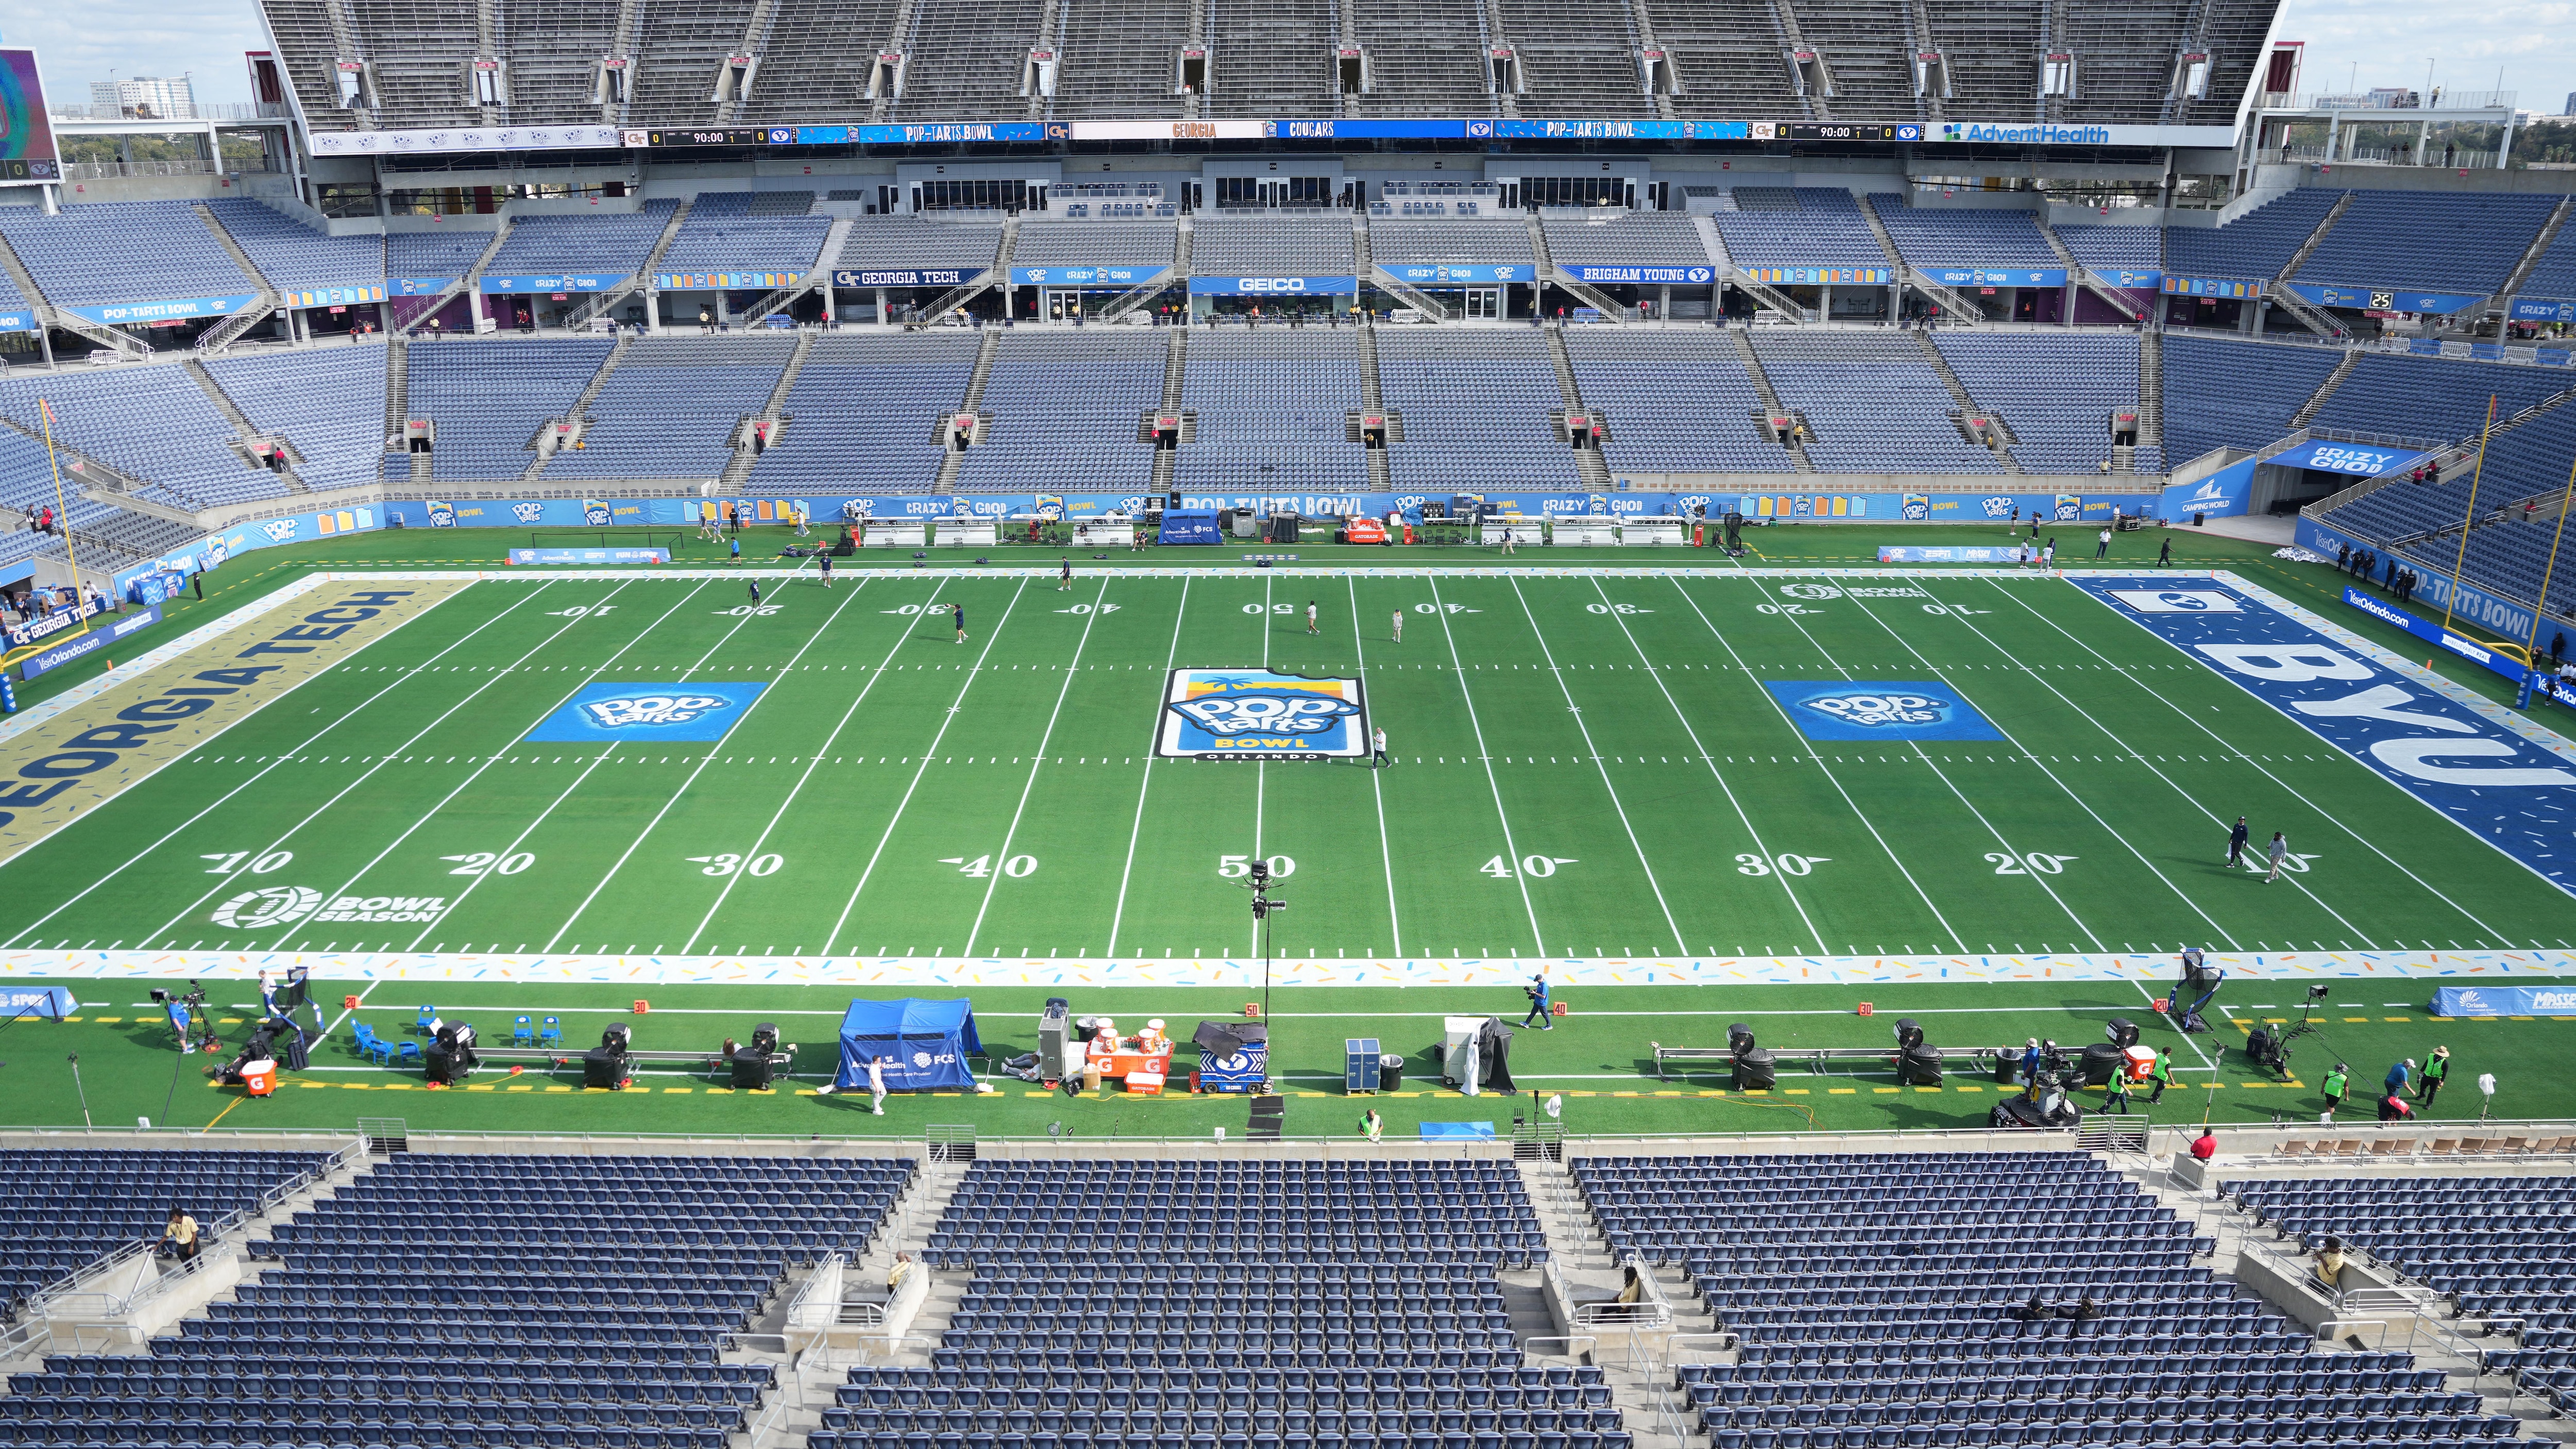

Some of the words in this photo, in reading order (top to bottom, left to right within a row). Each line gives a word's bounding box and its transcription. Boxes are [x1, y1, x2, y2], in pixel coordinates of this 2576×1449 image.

[906, 125, 961, 141] POP-TARTS
[964, 125, 994, 140] BOWL
[1173, 123, 1216, 138] GEORGIA
[1290, 122, 1334, 137] COUGARS
[1547, 122, 1602, 137] POP-TARTS
[1605, 122, 1634, 137] BOWL
[1780, 127, 1786, 135] 0
[1821, 127, 1850, 138] 90:00
[1885, 128, 1891, 137] 0
[1968, 123, 2109, 143] AdventHealth
[653, 134, 659, 143] 0
[694, 132, 723, 142] 90:00
[758, 132, 764, 141] 0
[862, 272, 917, 284] GEORGIA
[925, 271, 959, 283] TECH
[1584, 268, 1641, 280] BRIGHAM
[1644, 268, 1685, 280] YOUNG
[1945, 272, 1971, 281] CRAZY
[577, 278, 596, 287] GOOD
[1239, 279, 1304, 291] GEICO
[2372, 295, 2389, 307] 25
[104, 305, 165, 319] POP-TARTS
[168, 303, 198, 314] BOWL
[2520, 306, 2555, 315] CRAZY
[2315, 446, 2394, 464] CRAZY
[2310, 455, 2384, 474] GOOD
[614, 506, 640, 516] BOWL
[907, 503, 948, 514] CRAZY
[976, 502, 1007, 514] GOOD
[1068, 502, 1096, 512] BOWL
[1306, 497, 1365, 515] BOWL
[1543, 500, 1585, 511] CRAZY
[1612, 500, 1642, 511] GOOD
[1933, 501, 1959, 510] BOWL
[2084, 502, 2111, 511] BOWL
[2182, 502, 2209, 512] CAMPING
[2209, 500, 2229, 509] WORLD
[457, 507, 484, 517] BOWL
[1925, 550, 1951, 558] ESPN
[172, 555, 193, 570] GOOD
[563, 606, 618, 617] 10
[730, 605, 784, 616] 20
[899, 605, 951, 615] 30
[1070, 604, 1121, 615] 40
[1243, 604, 1293, 614] 50
[1415, 604, 1465, 614] 40
[1587, 604, 1636, 614] 30
[1756, 604, 1807, 614] 20
[1923, 605, 1975, 615] 10
[2348, 590, 2409, 628] VisitOrlando.com
[31, 613, 72, 638] GEORGIA
[117, 619, 142, 633] UNBELIEVABLY
[141, 614, 151, 622] REAL
[236, 590, 415, 657] TECH
[2482, 600, 2532, 640] BOWL
[2445, 636, 2477, 656] UNBELIEVABLY
[2477, 651, 2488, 660] REAL
[36, 638, 99, 671] VisitOrlando.com
[600, 711, 699, 725] tarts
[1845, 710, 1933, 724] tarts
[2194, 643, 2576, 786] BYU
[1205, 715, 1325, 732] tarts
[1215, 739, 1309, 748] BOWL
[205, 851, 293, 873] 10
[448, 853, 535, 875] 20
[702, 854, 784, 876] 30
[959, 855, 1037, 877] 40
[1218, 855, 1295, 877] 50
[1480, 855, 1556, 877] 40
[1735, 854, 1811, 876] 30
[1985, 853, 2063, 875] 20
[329, 897, 446, 911] BOWL
[314, 911, 436, 923] SEASON
[11, 994, 48, 1007] SPOT
[346, 997, 355, 1008] 20
[2157, 1000, 2167, 1010] 20
[2532, 992, 2576, 1008] MASSE
[635, 1002, 646, 1012] 30
[1247, 1005, 1258, 1015] 50
[1555, 1003, 1566, 1014] 40
[1861, 1004, 1872, 1015] 30
[934, 1054, 955, 1064] FCS
[1097, 1058, 1112, 1072] G
[1145, 1059, 1160, 1073] G
[2138, 1062, 2151, 1075] G
[249, 1077, 265, 1090] G
